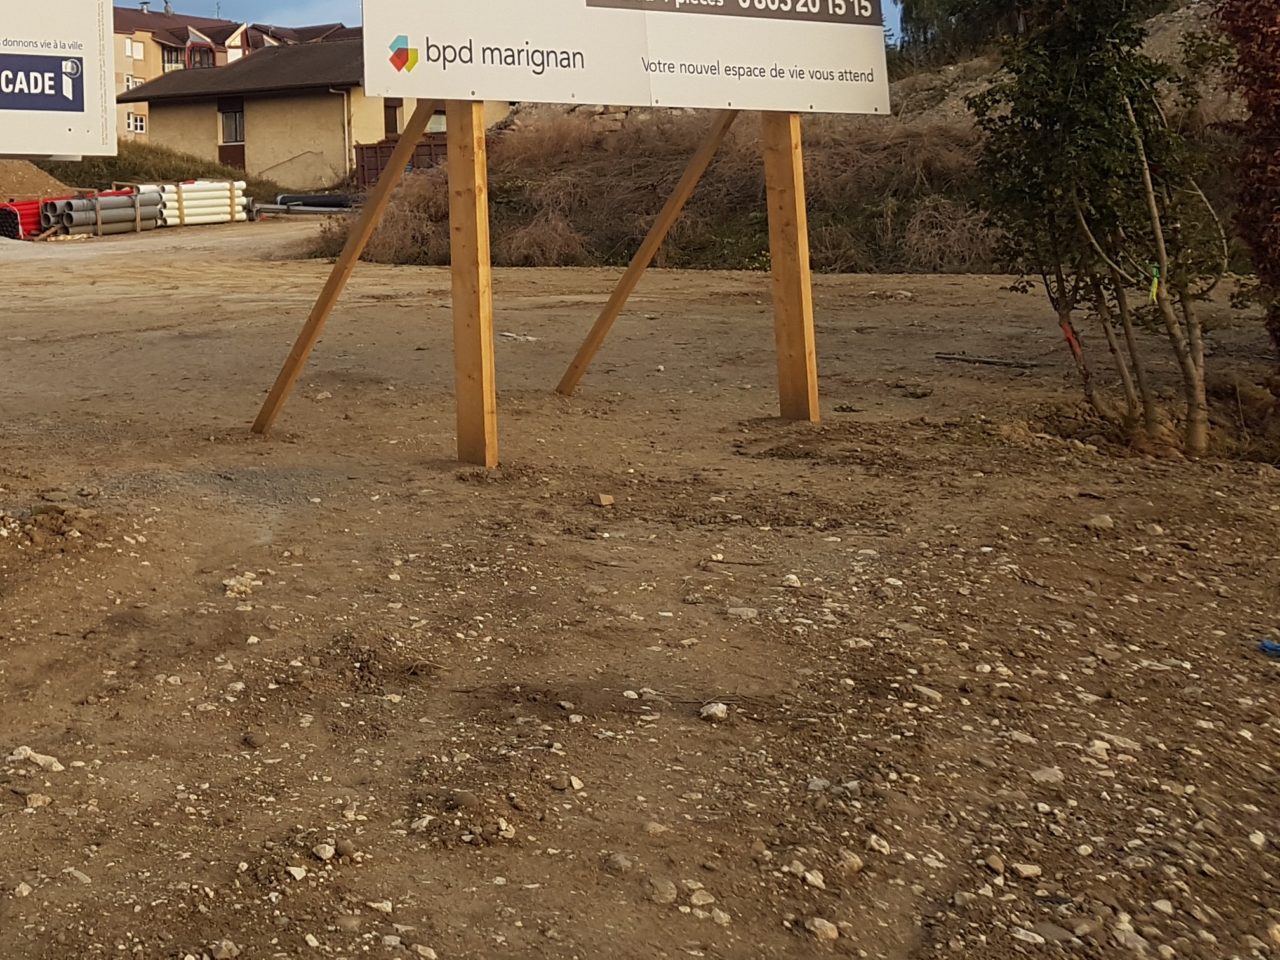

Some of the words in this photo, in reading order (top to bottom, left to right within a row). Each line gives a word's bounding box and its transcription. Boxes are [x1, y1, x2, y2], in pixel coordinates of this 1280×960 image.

[2, 38, 39, 48] donnons
[40, 40, 51, 49] vie
[59, 40, 66, 50] la
[67, 41, 83, 51] ville
[426, 36, 473, 71] bpd
[481, 41, 585, 75] marignan
[641, 56, 675, 74] Votre
[679, 60, 720, 76] nouvel
[724, 65, 766, 80] espace
[770, 64, 785, 79] de
[788, 65, 805, 80] vie
[808, 68, 835, 81] vous
[837, 68, 874, 83] attend
